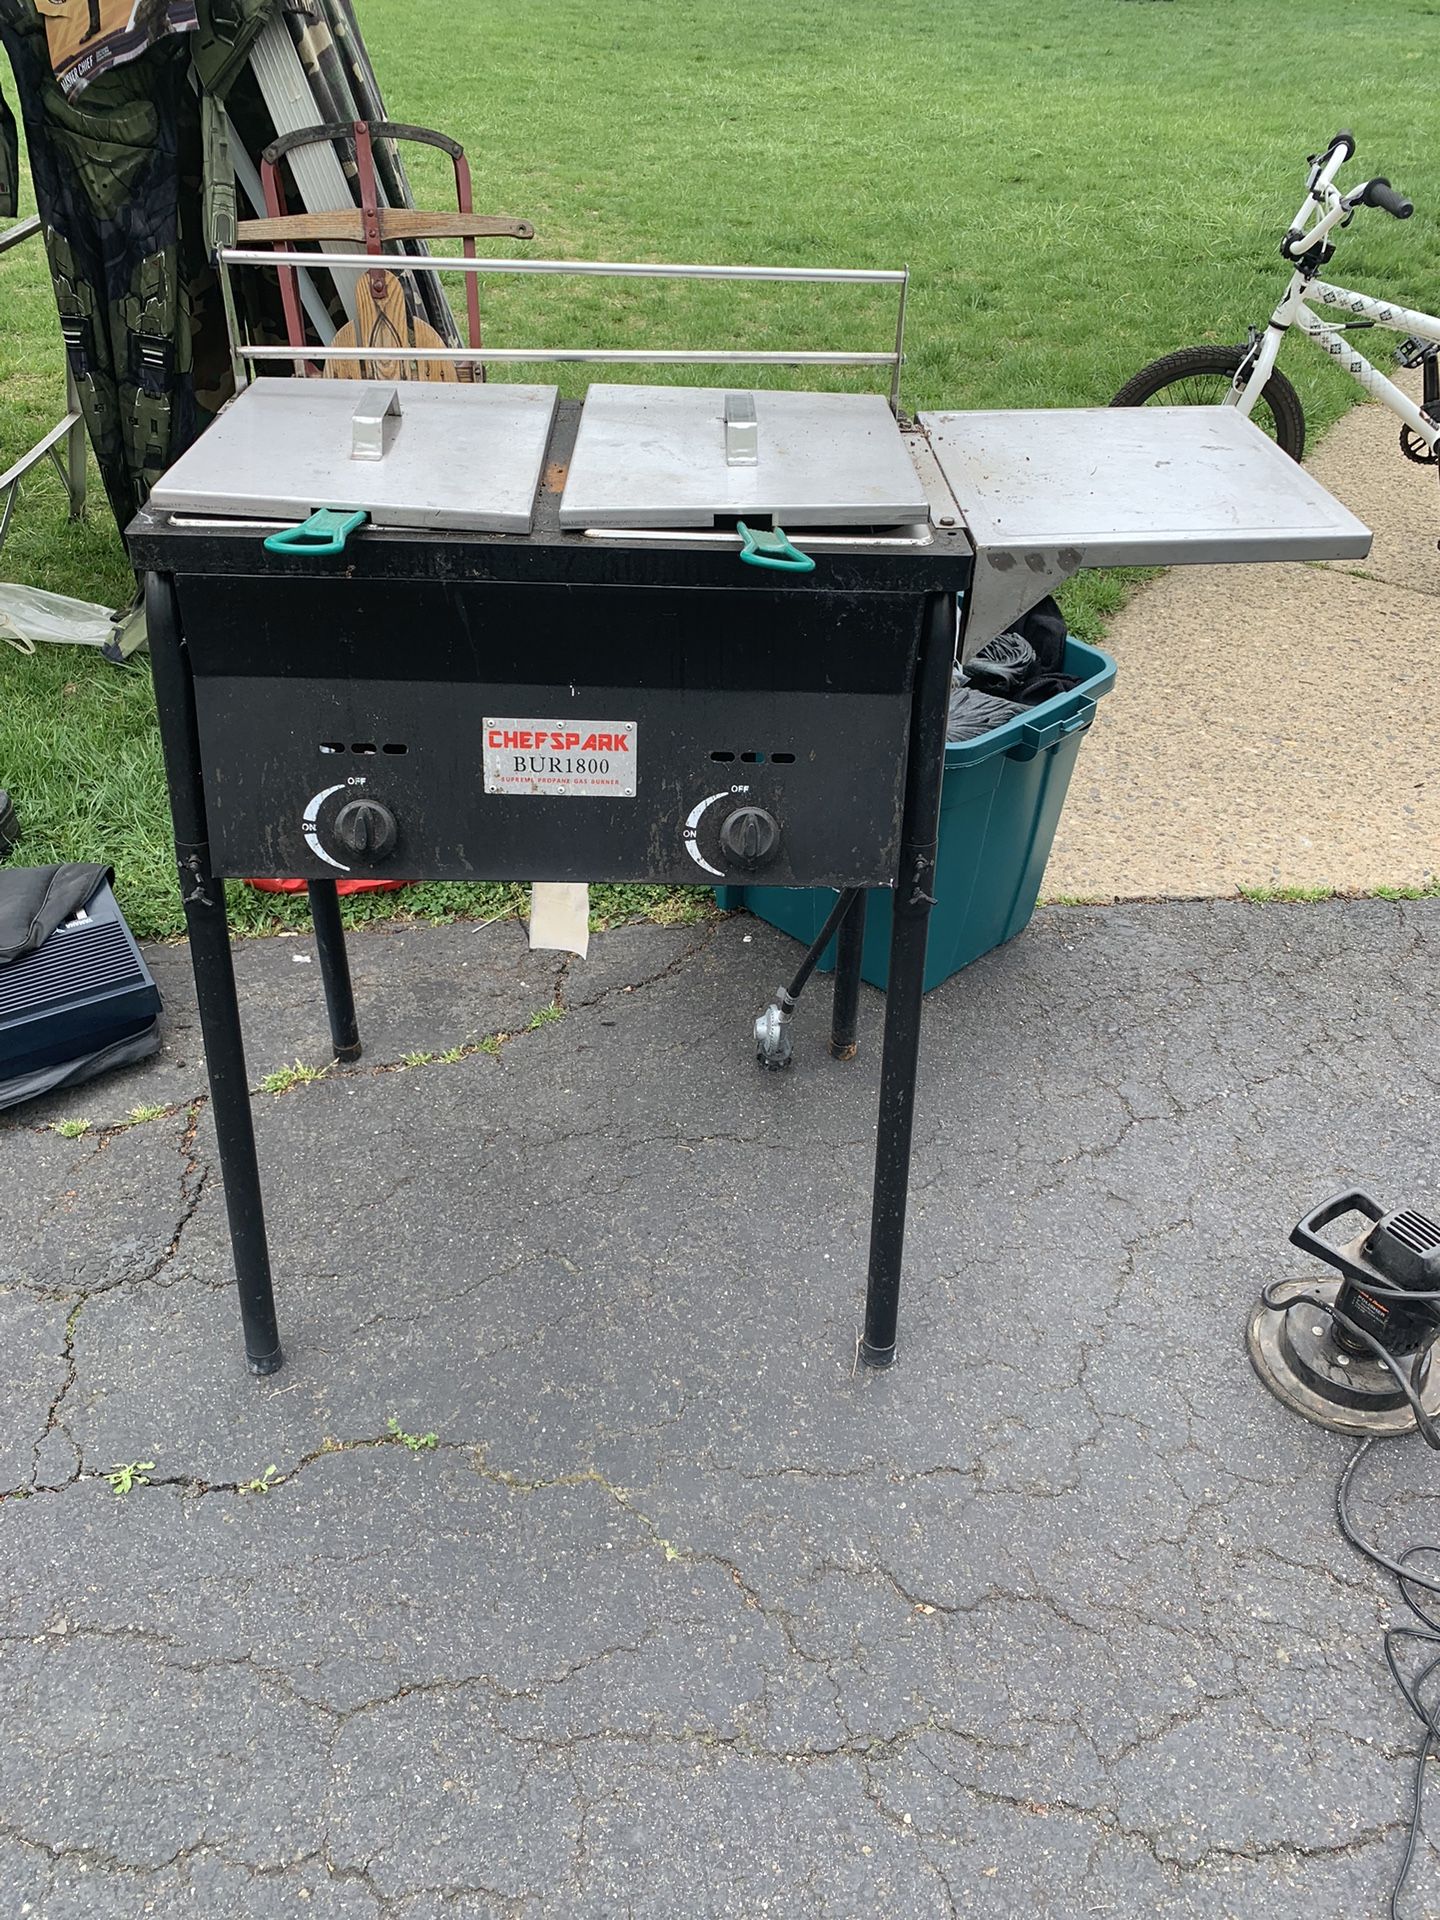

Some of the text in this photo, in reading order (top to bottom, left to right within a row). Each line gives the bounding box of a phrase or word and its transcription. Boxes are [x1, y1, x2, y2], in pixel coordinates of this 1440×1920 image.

[60, 67, 80, 94] MASTER
[78, 54, 93, 76] CHIEF
[487, 730, 630, 752] CHEFSPARK
[513, 756, 610, 774] BUR1800
[347, 776, 367, 785] OFF
[731, 784, 750, 793] OFF
[301, 823, 317, 832] ON
[683, 829, 697, 838] ON
